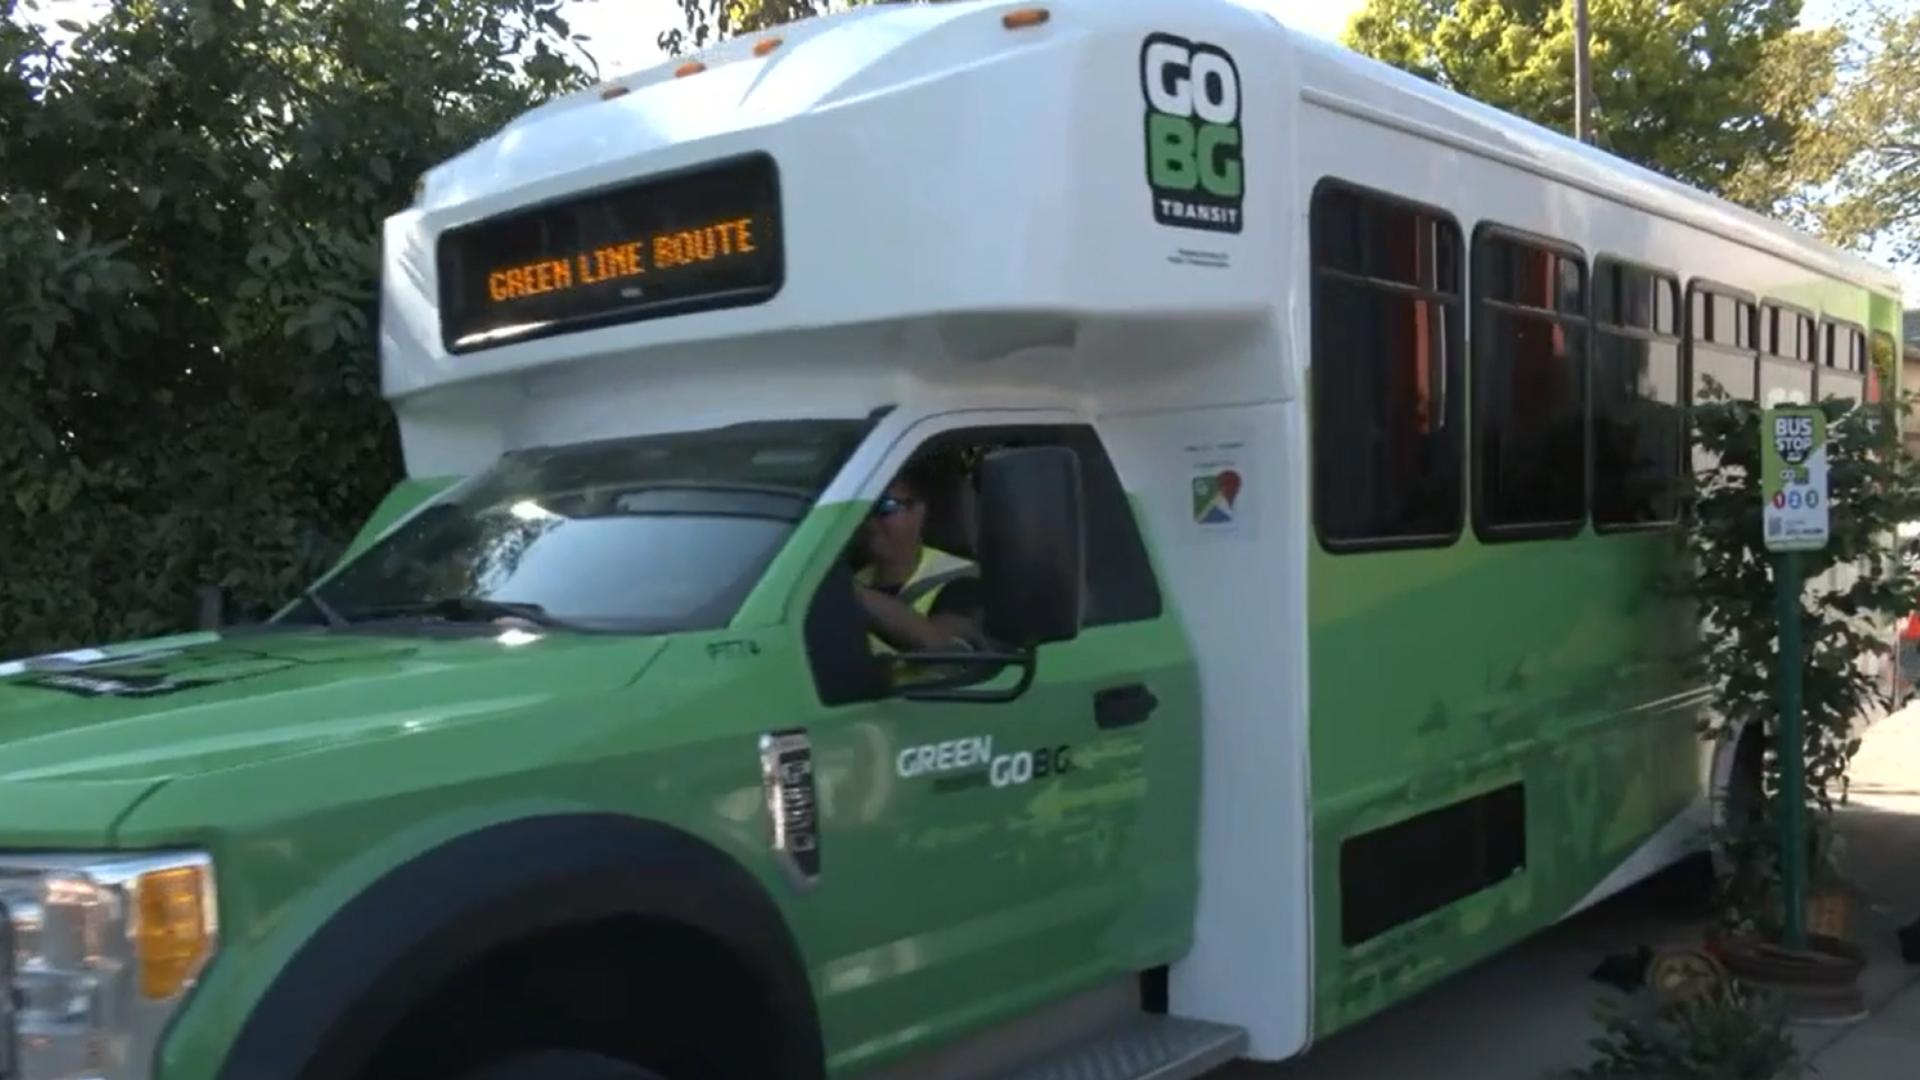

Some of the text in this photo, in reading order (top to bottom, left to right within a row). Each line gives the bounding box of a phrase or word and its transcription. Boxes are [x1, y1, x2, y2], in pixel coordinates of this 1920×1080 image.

[1144, 40, 1239, 125] GO
[1148, 112, 1242, 198] BG
[1160, 199, 1239, 225] TRANSIT
[488, 217, 756, 302] GREEN LINE ROUTE
[1774, 416, 1813, 437] BUS
[1774, 436, 1813, 452] STOP
[896, 734, 993, 778] GREEN
